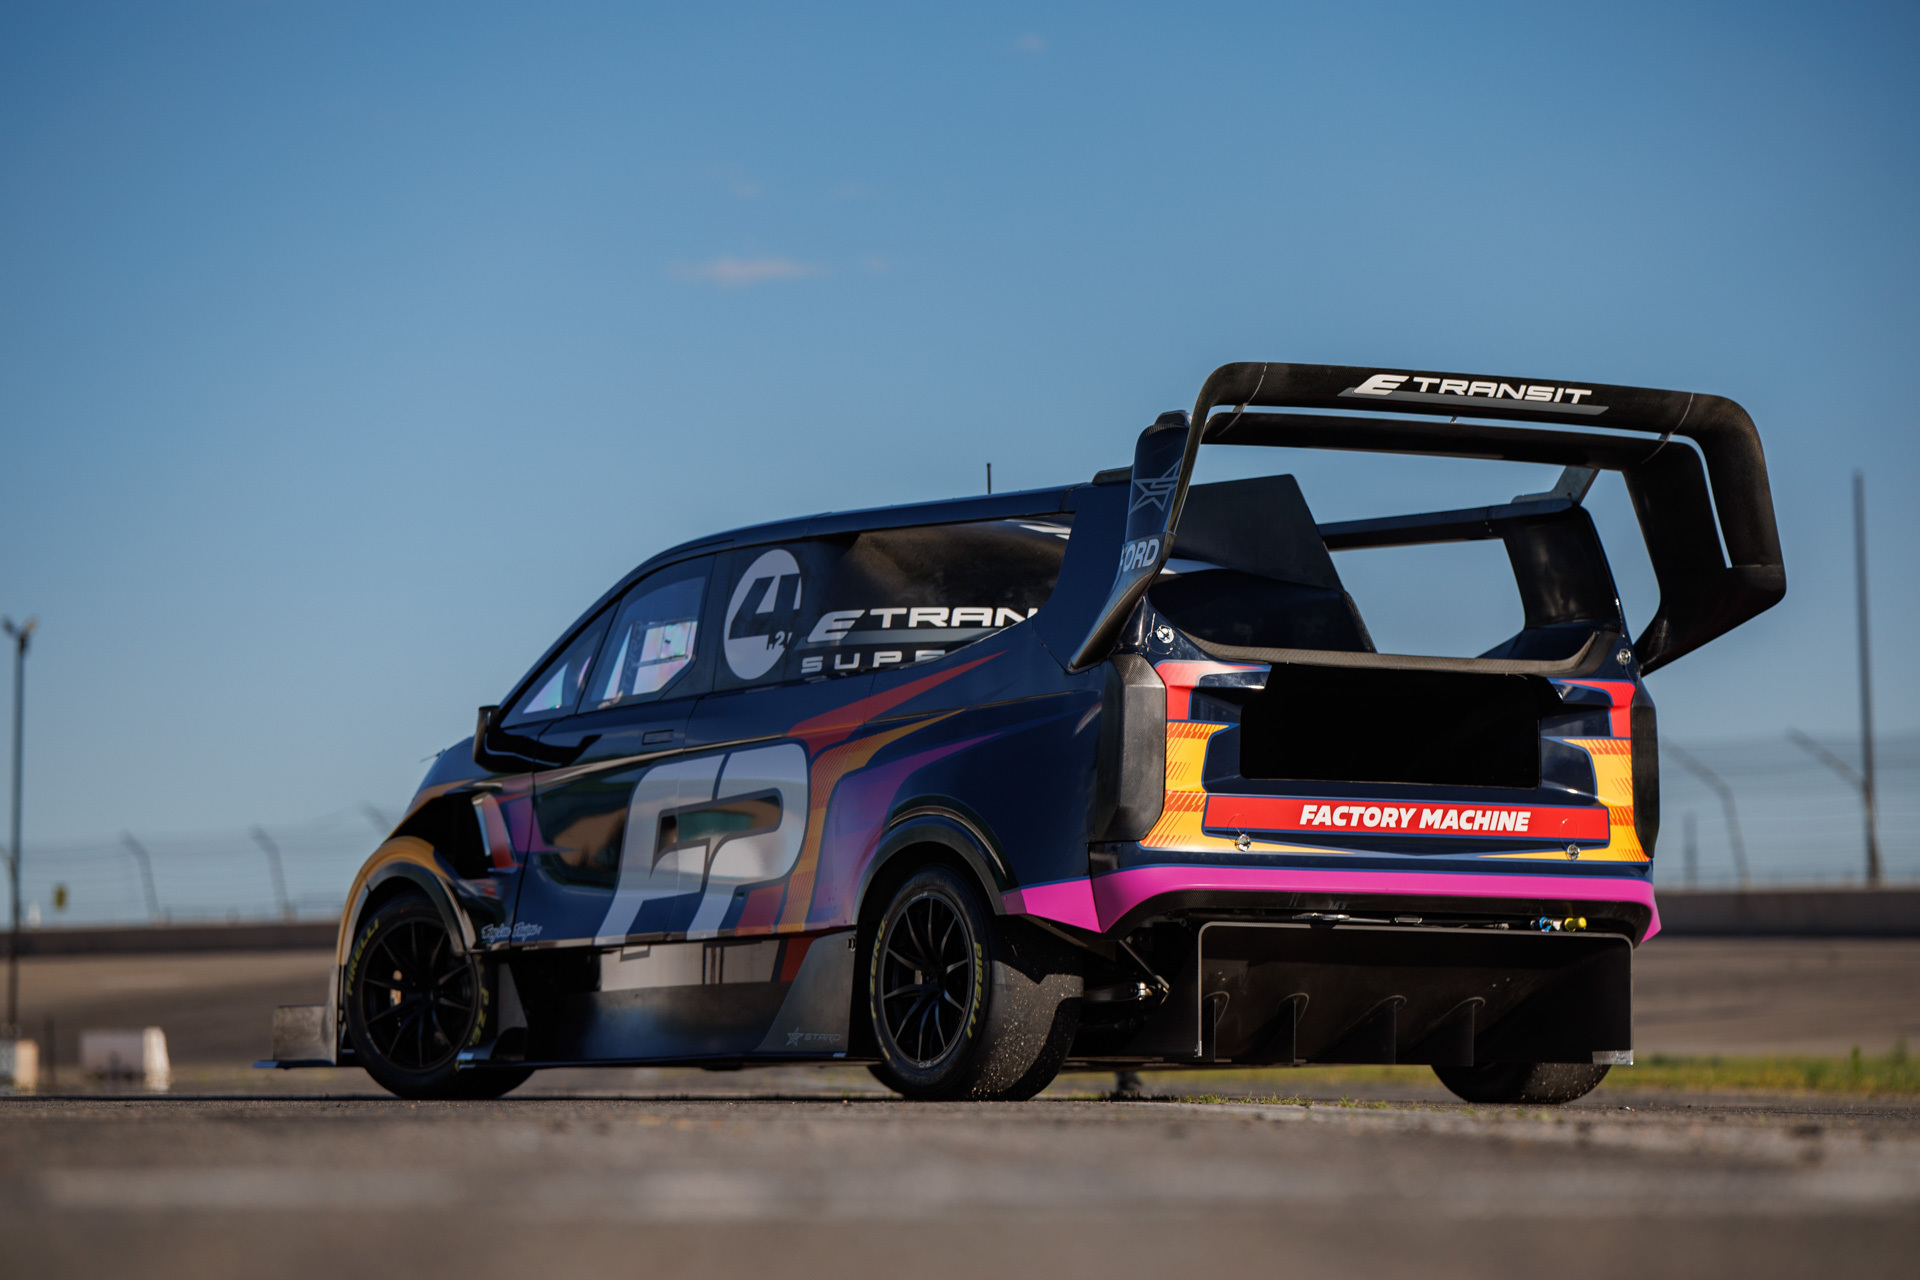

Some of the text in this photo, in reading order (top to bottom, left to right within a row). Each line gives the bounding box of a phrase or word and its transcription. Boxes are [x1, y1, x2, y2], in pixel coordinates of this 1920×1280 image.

[1413, 377, 1592, 405] TRANSIT
[1299, 804, 1531, 832] FACTORY MACHINE
[346, 918, 379, 995] PIRELLI
[967, 942, 983, 1039] PIRELLI
[804, 1033, 841, 1045] STARD
